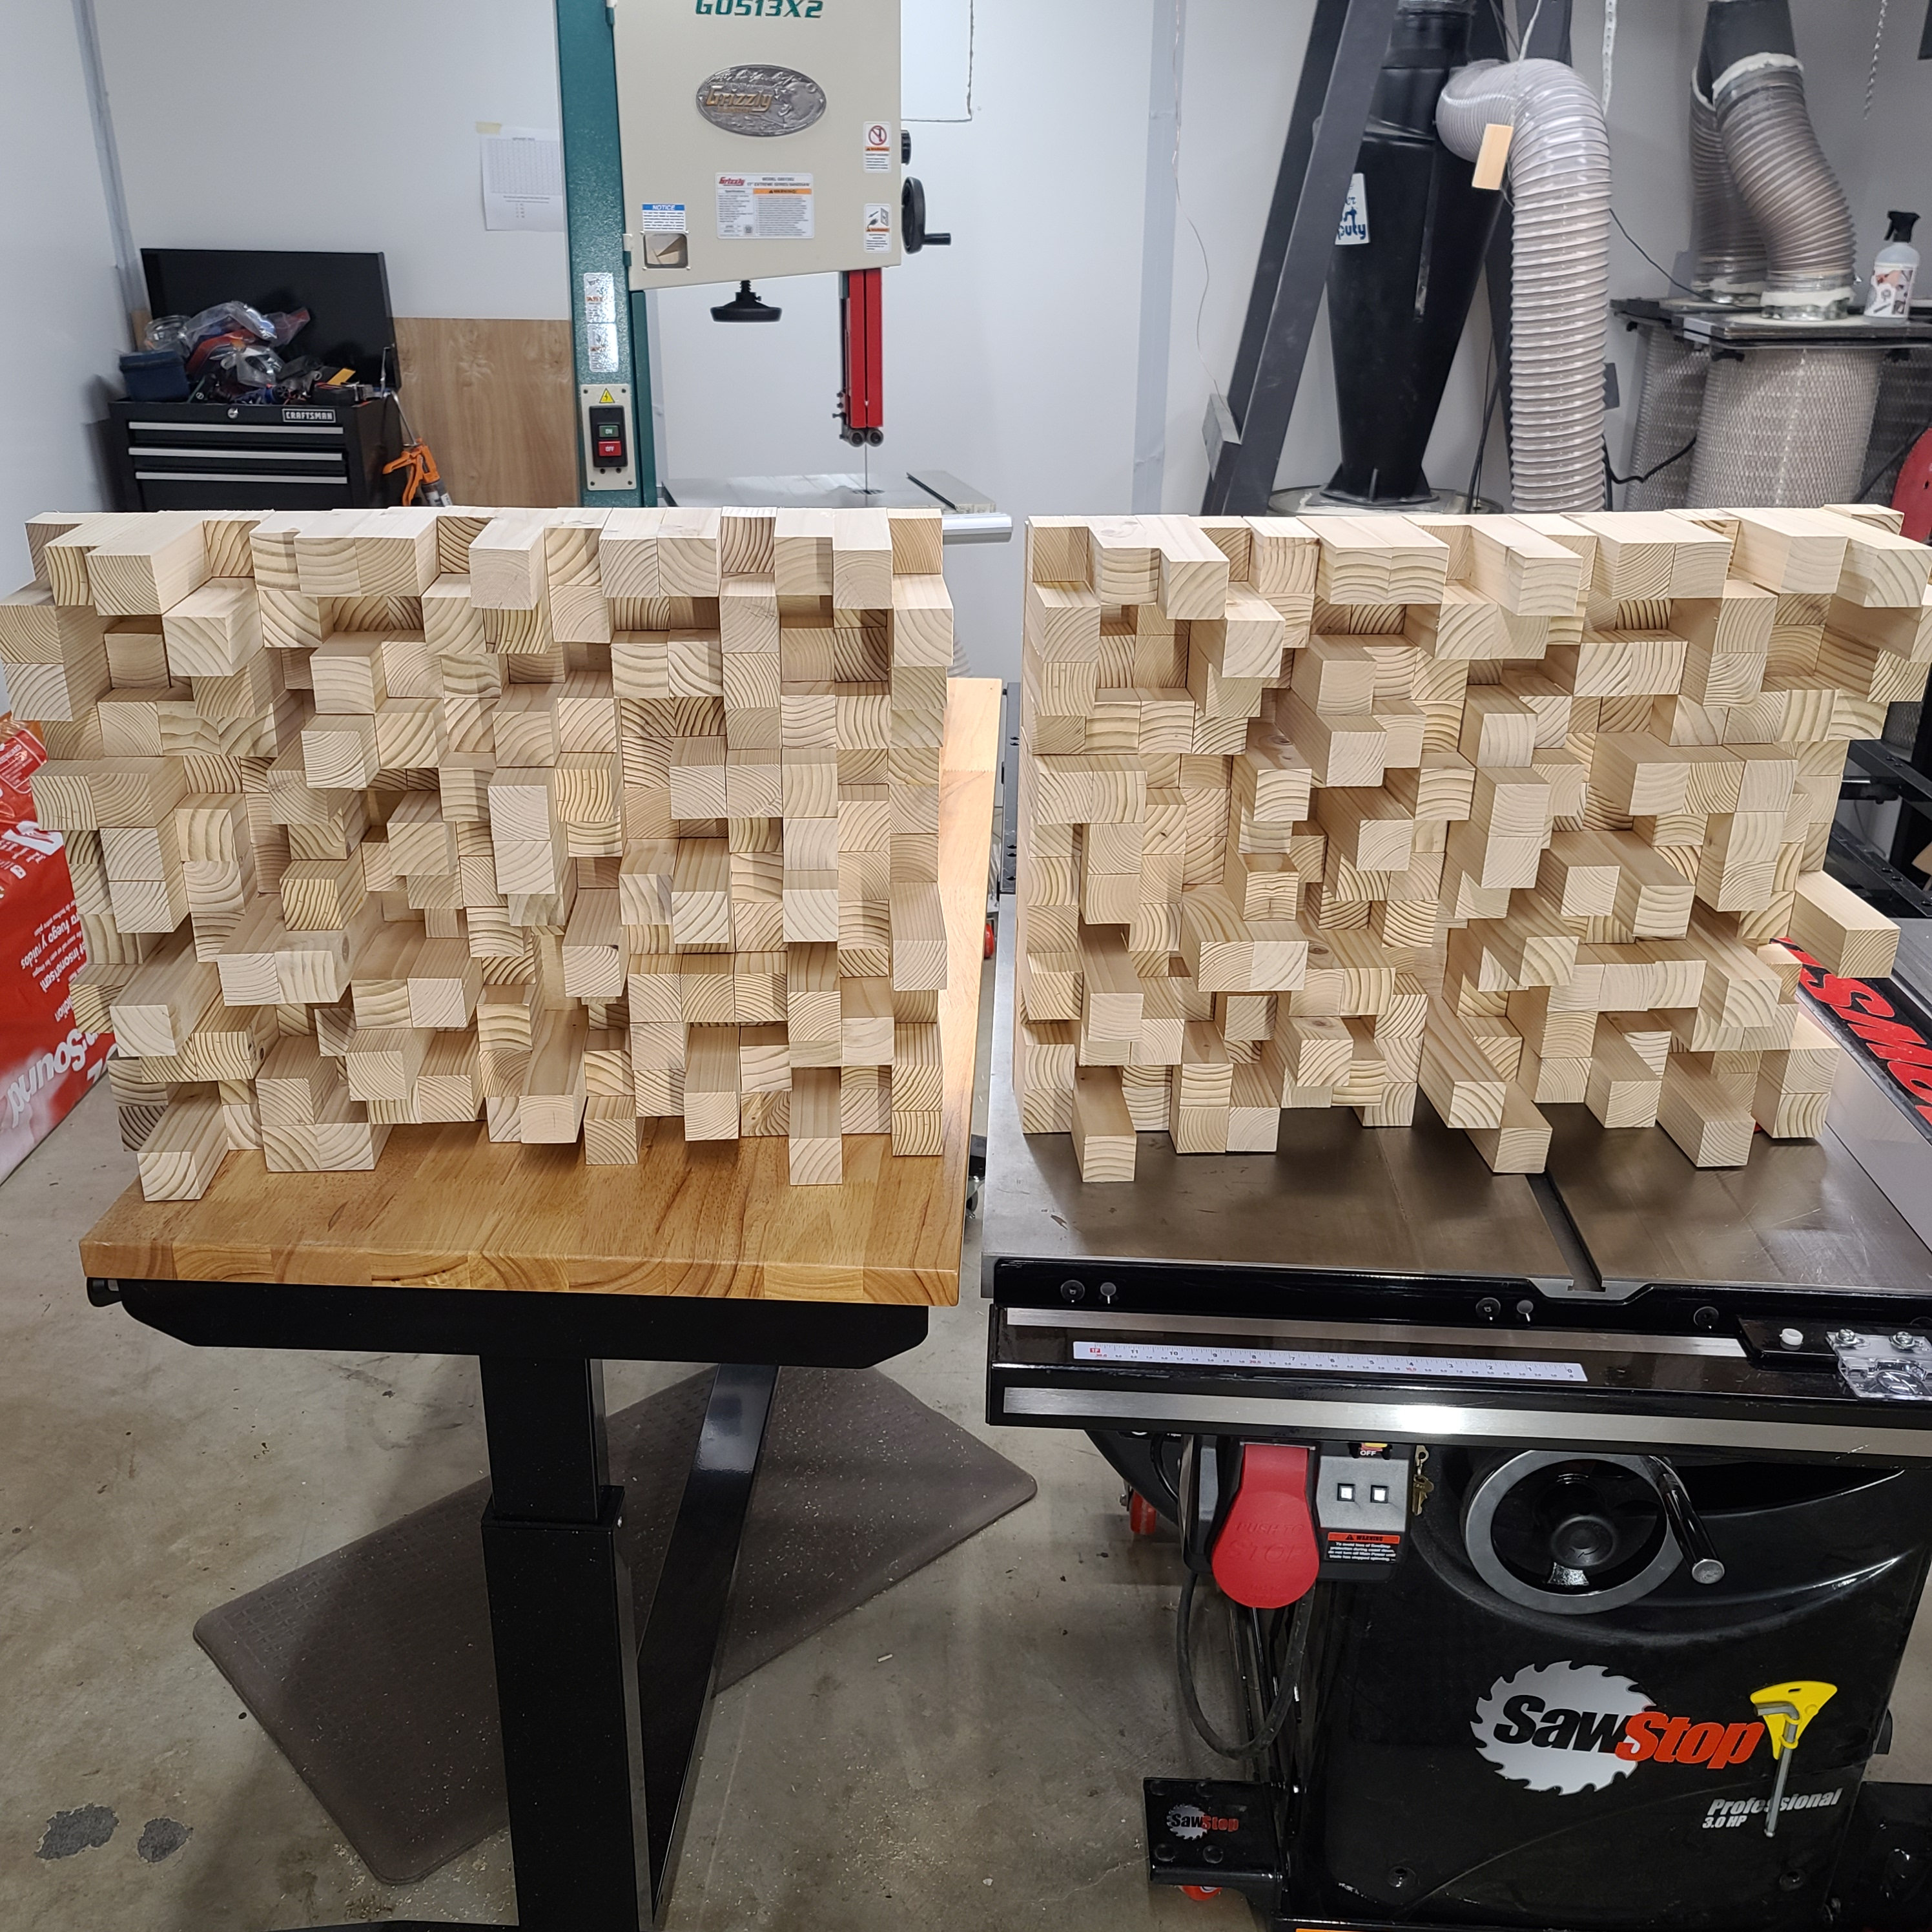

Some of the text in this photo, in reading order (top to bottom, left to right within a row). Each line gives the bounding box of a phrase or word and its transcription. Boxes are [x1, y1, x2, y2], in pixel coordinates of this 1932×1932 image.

[706, 85, 774, 113] Grizzly
[285, 411, 333, 420] CRAFTSMAN
[48, 920, 70, 943] fuego
[1494, 1694, 1764, 1769] SawStop
[1171, 1813, 1239, 1832] SawStop
[1702, 1815, 1747, 1828] 3.0 HP
